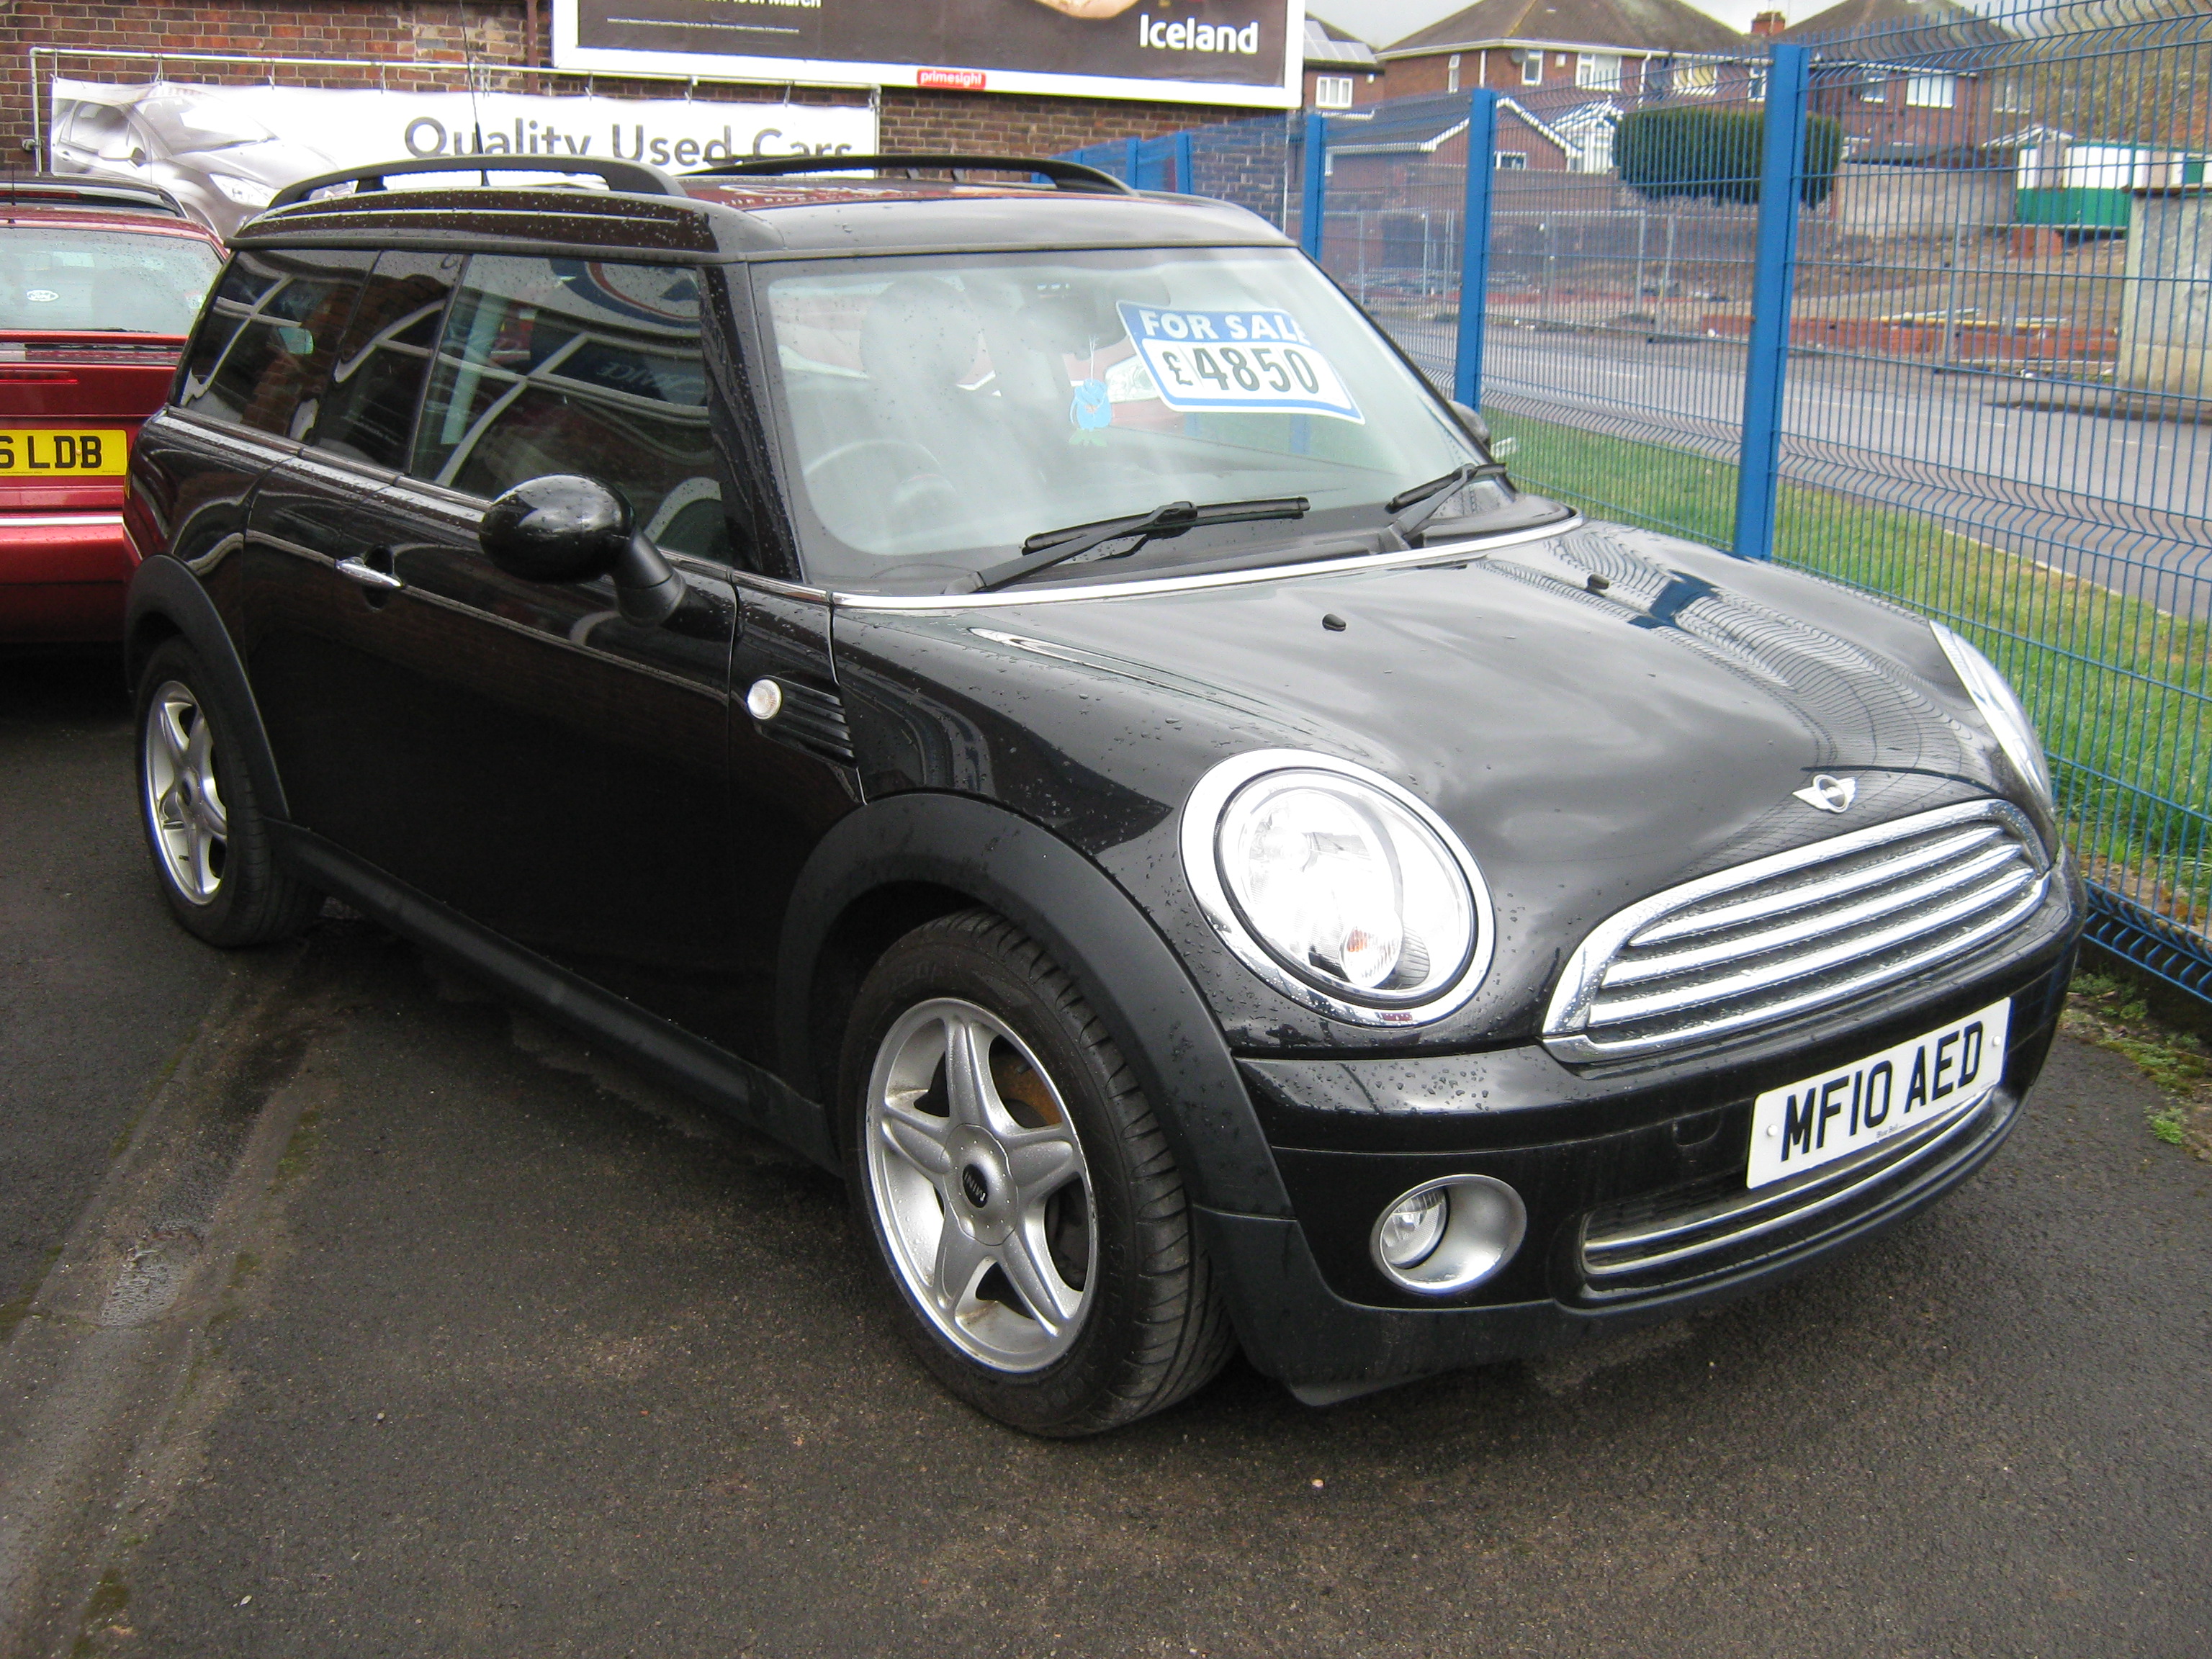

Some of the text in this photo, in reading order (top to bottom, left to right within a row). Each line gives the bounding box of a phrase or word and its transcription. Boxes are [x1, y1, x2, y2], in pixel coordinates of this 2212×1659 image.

[1140, 13, 1259, 55] Iceland
[920, 71, 982, 87] primesight
[404, 116, 591, 158] Quality
[612, 123, 732, 166] Used
[1139, 309, 1310, 346] FOR SALE
[1162, 346, 1319, 394] £4850
[27, 436, 102, 468] LDB
[1781, 1020, 1983, 1162] MF10 AED
